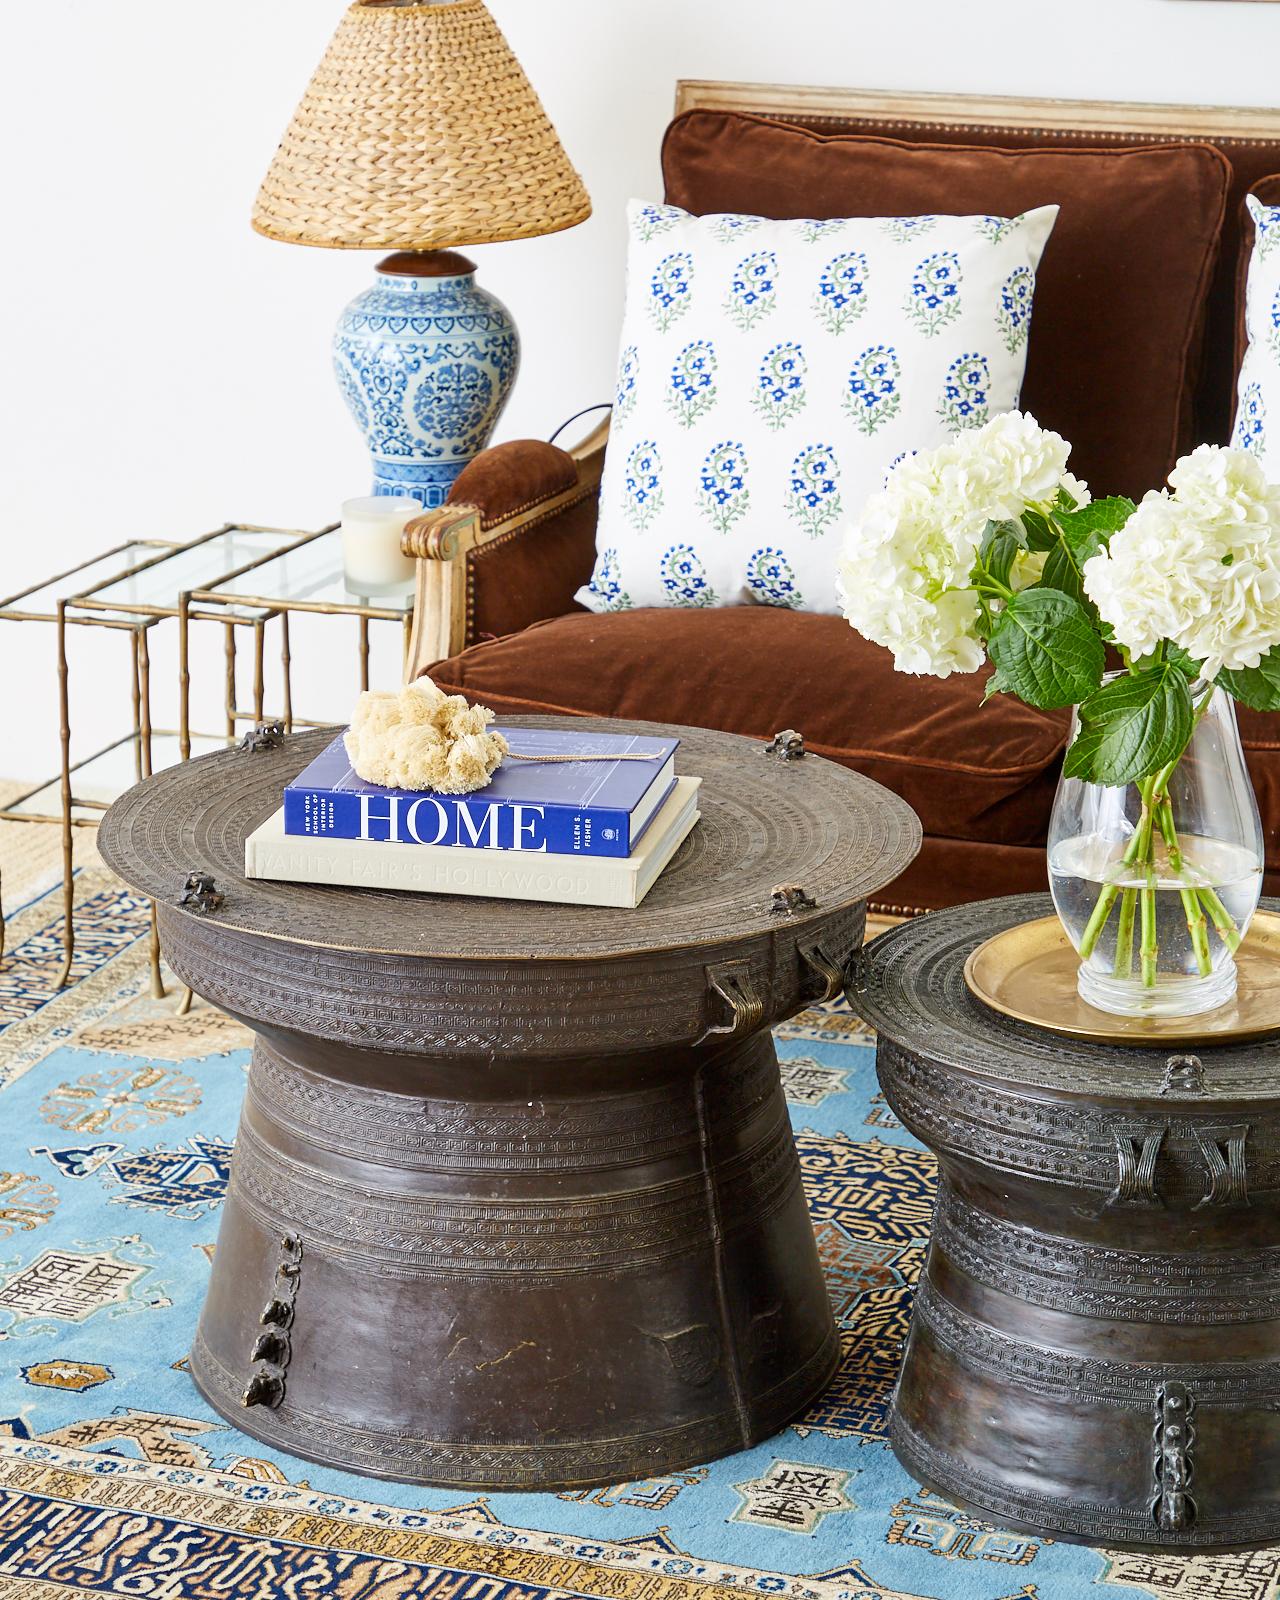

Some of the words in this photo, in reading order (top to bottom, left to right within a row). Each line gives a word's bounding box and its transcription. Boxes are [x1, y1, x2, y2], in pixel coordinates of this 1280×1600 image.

[312, 794, 319, 804] OF
[355, 794, 547, 853] HOME
[573, 814, 581, 822] S.
[573, 824, 581, 850] ELLEN
[584, 818, 592, 847] FISHER
[262, 852, 338, 875] VANITY
[351, 859, 424, 883] FAIR'S
[433, 863, 591, 896] HOLLYWOOD
